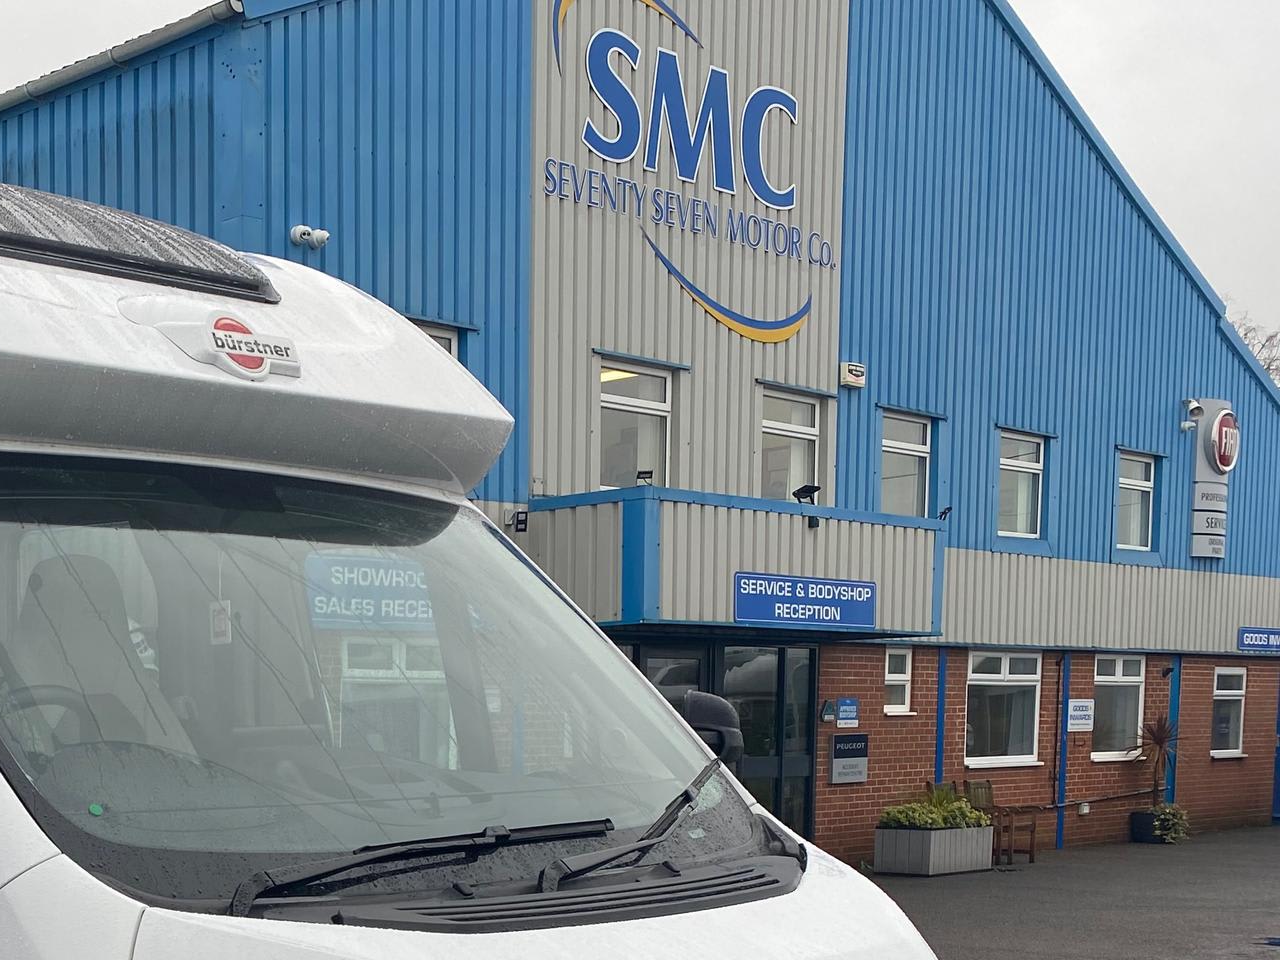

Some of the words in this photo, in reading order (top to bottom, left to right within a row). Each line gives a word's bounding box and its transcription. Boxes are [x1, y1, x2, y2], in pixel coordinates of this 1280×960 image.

[581, 27, 798, 211] SMC
[543, 157, 648, 219] SEVENTY
[651, 187, 718, 239] SEVEN
[726, 207, 801, 261] MOTOR
[211, 331, 290, 358] bürstner
[740, 579, 792, 596] SERVICE
[796, 584, 805, 597] &
[808, 584, 871, 602] BODYSHOP
[314, 596, 375, 617] SALES
[775, 603, 841, 621] RECEPTION
[1243, 633, 1268, 645] GOODS
